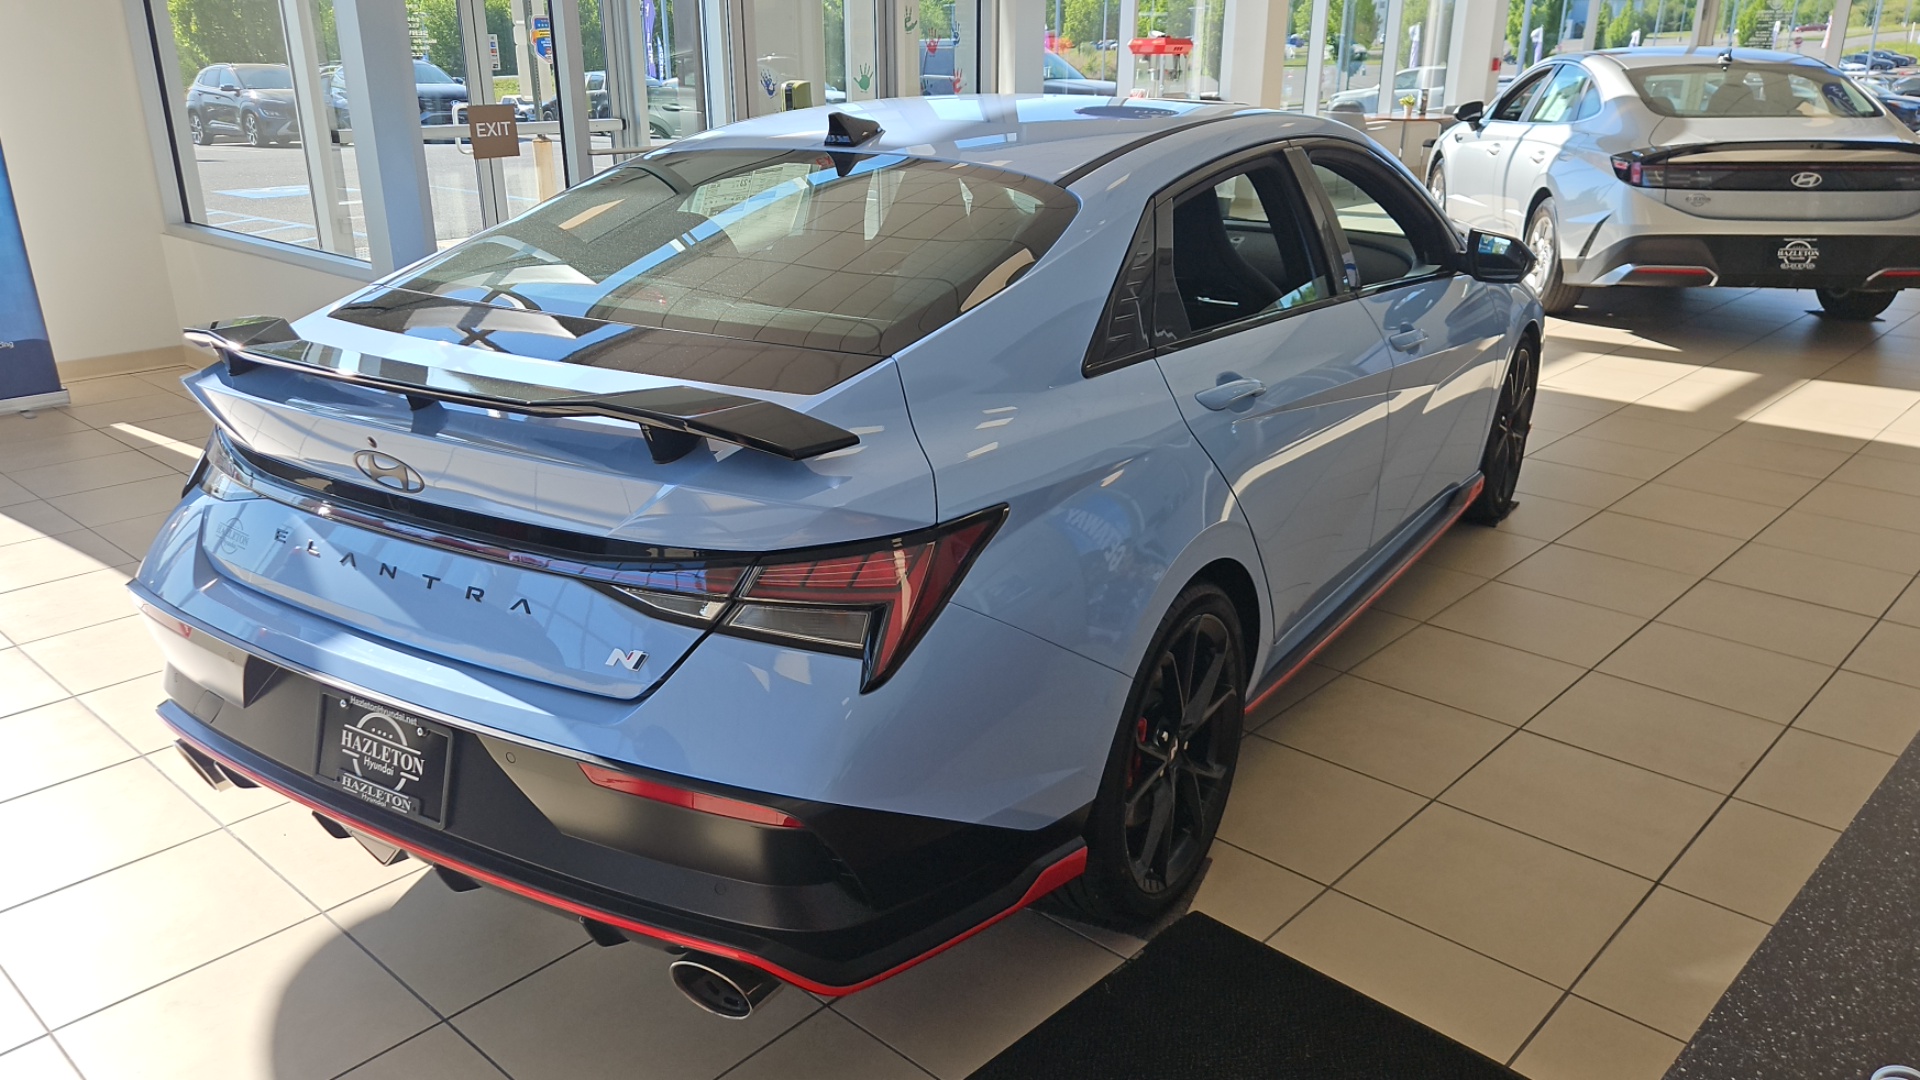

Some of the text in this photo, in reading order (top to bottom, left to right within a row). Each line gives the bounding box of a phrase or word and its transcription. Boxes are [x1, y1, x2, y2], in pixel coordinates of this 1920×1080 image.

[476, 121, 510, 138] EXIT
[274, 528, 531, 615] ELANTRA
[350, 695, 418, 726] HazletonHyundai.net
[340, 729, 425, 775] HAZLETON
[363, 756, 394, 776] Hyundai
[341, 776, 411, 811] HAZLETON
